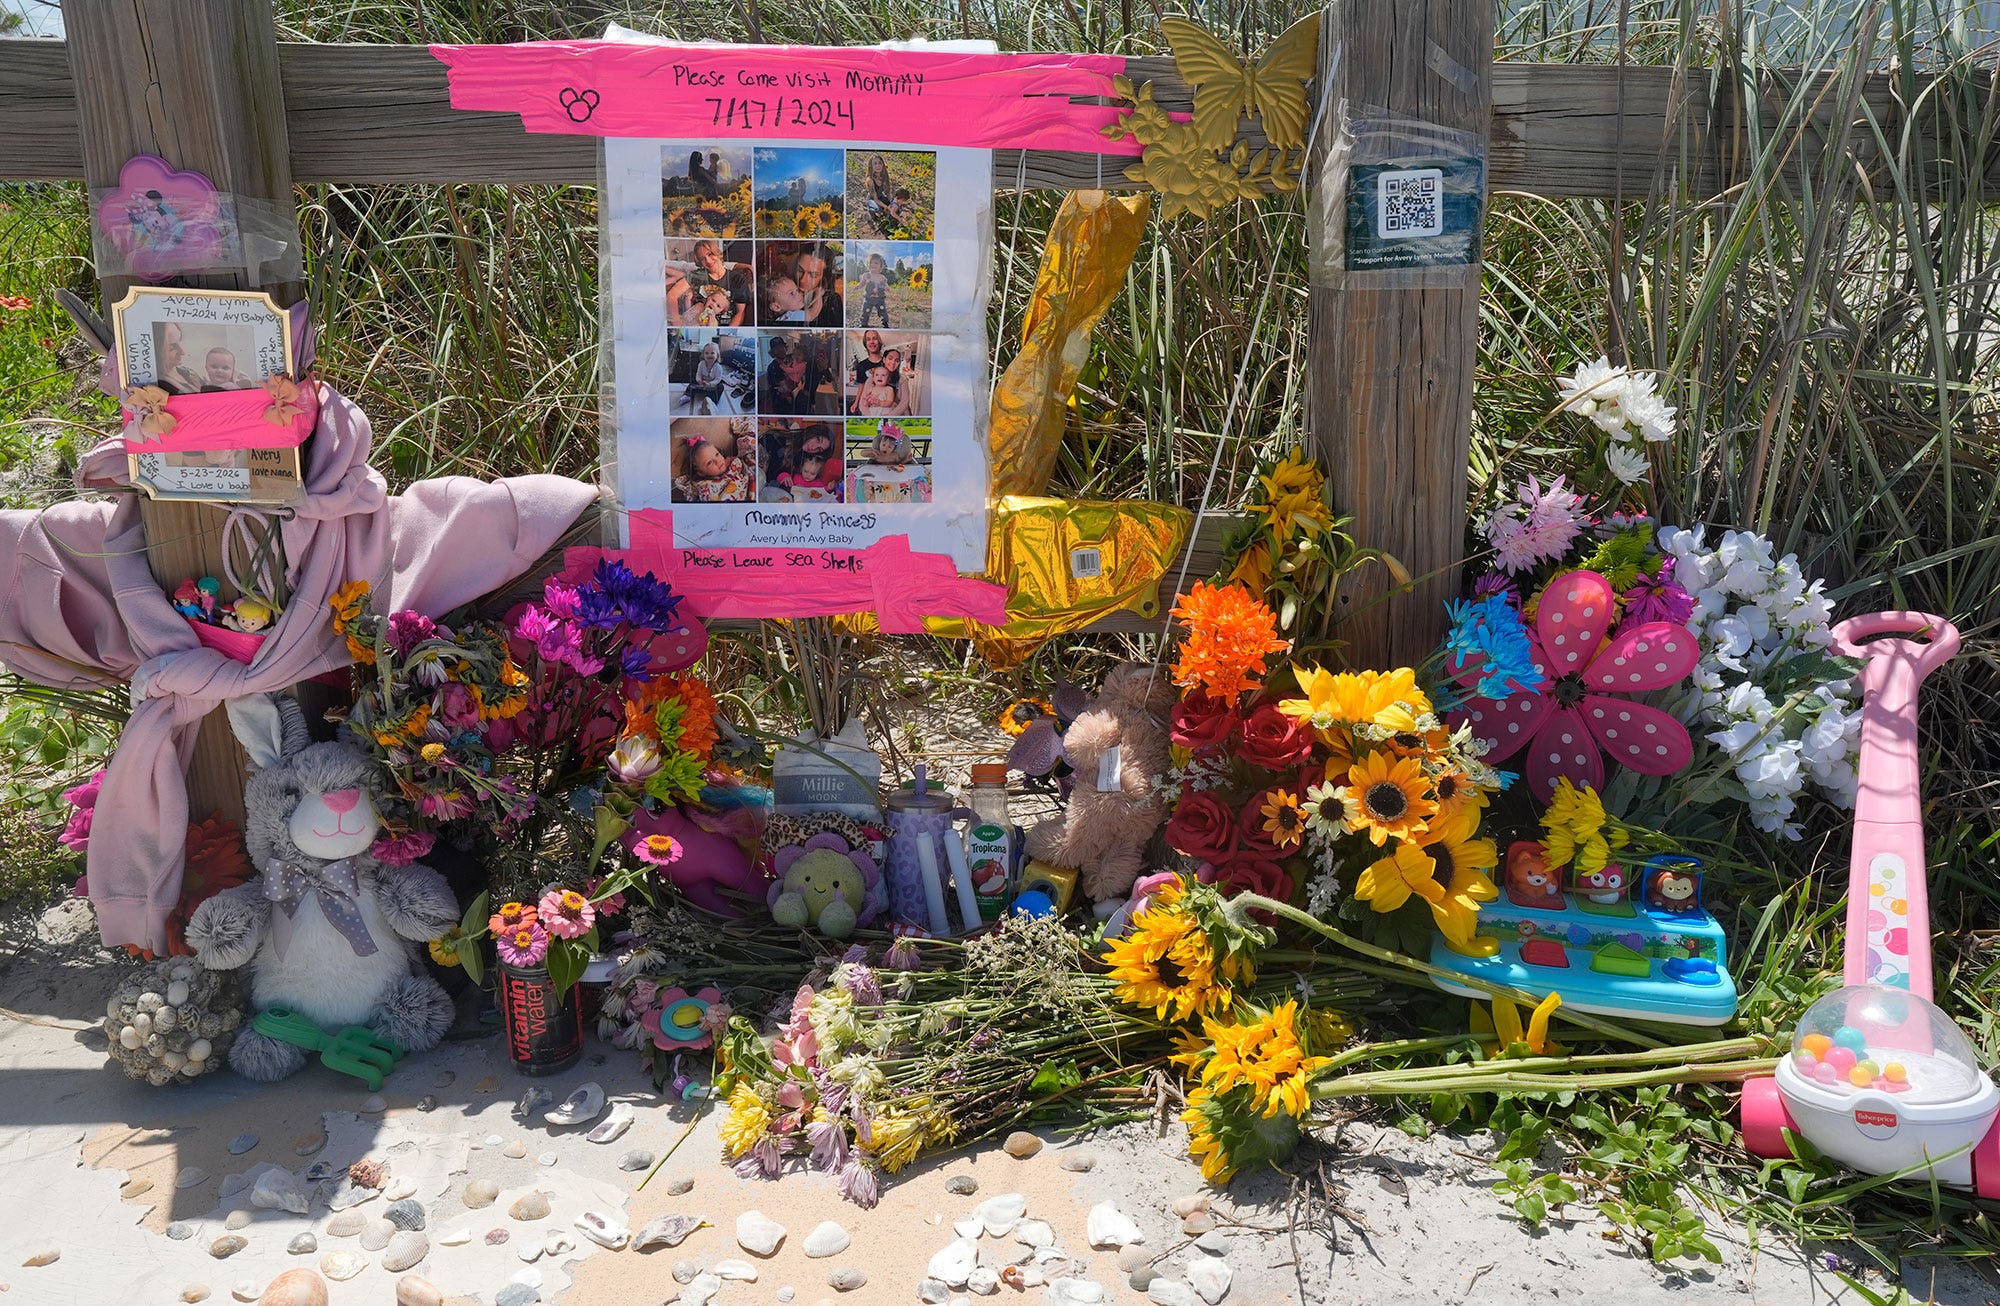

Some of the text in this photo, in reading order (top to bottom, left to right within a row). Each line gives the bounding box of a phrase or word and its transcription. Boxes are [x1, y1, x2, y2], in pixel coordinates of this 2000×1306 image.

[672, 64, 726, 87] Please
[737, 71, 779, 87] Come
[785, 71, 831, 88] visit
[704, 95, 855, 131] 7/17/2024
[1395, 254, 1413, 262] Avery
[161, 296, 250, 310] Avery Lynn
[163, 306, 217, 320] 7-17-2024
[223, 312, 265, 325] Avy Baby
[140, 333, 152, 379] Forever
[250, 448, 281, 464] Avery
[180, 468, 240, 479] 5-23-2026
[176, 480, 186, 489] I
[819, 511, 877, 530] Princess
[749, 534, 854, 545] Avery Lynn Avy Baby
[683, 550, 726, 569] Please
[733, 552, 775, 568] Leave
[821, 551, 864, 574] Shells
[801, 776, 845, 792] Millie
[808, 792, 838, 801] MOON
[970, 843, 1007, 855] Tropicana
[526, 981, 547, 1037] water
[508, 979, 532, 1061] vitamin
